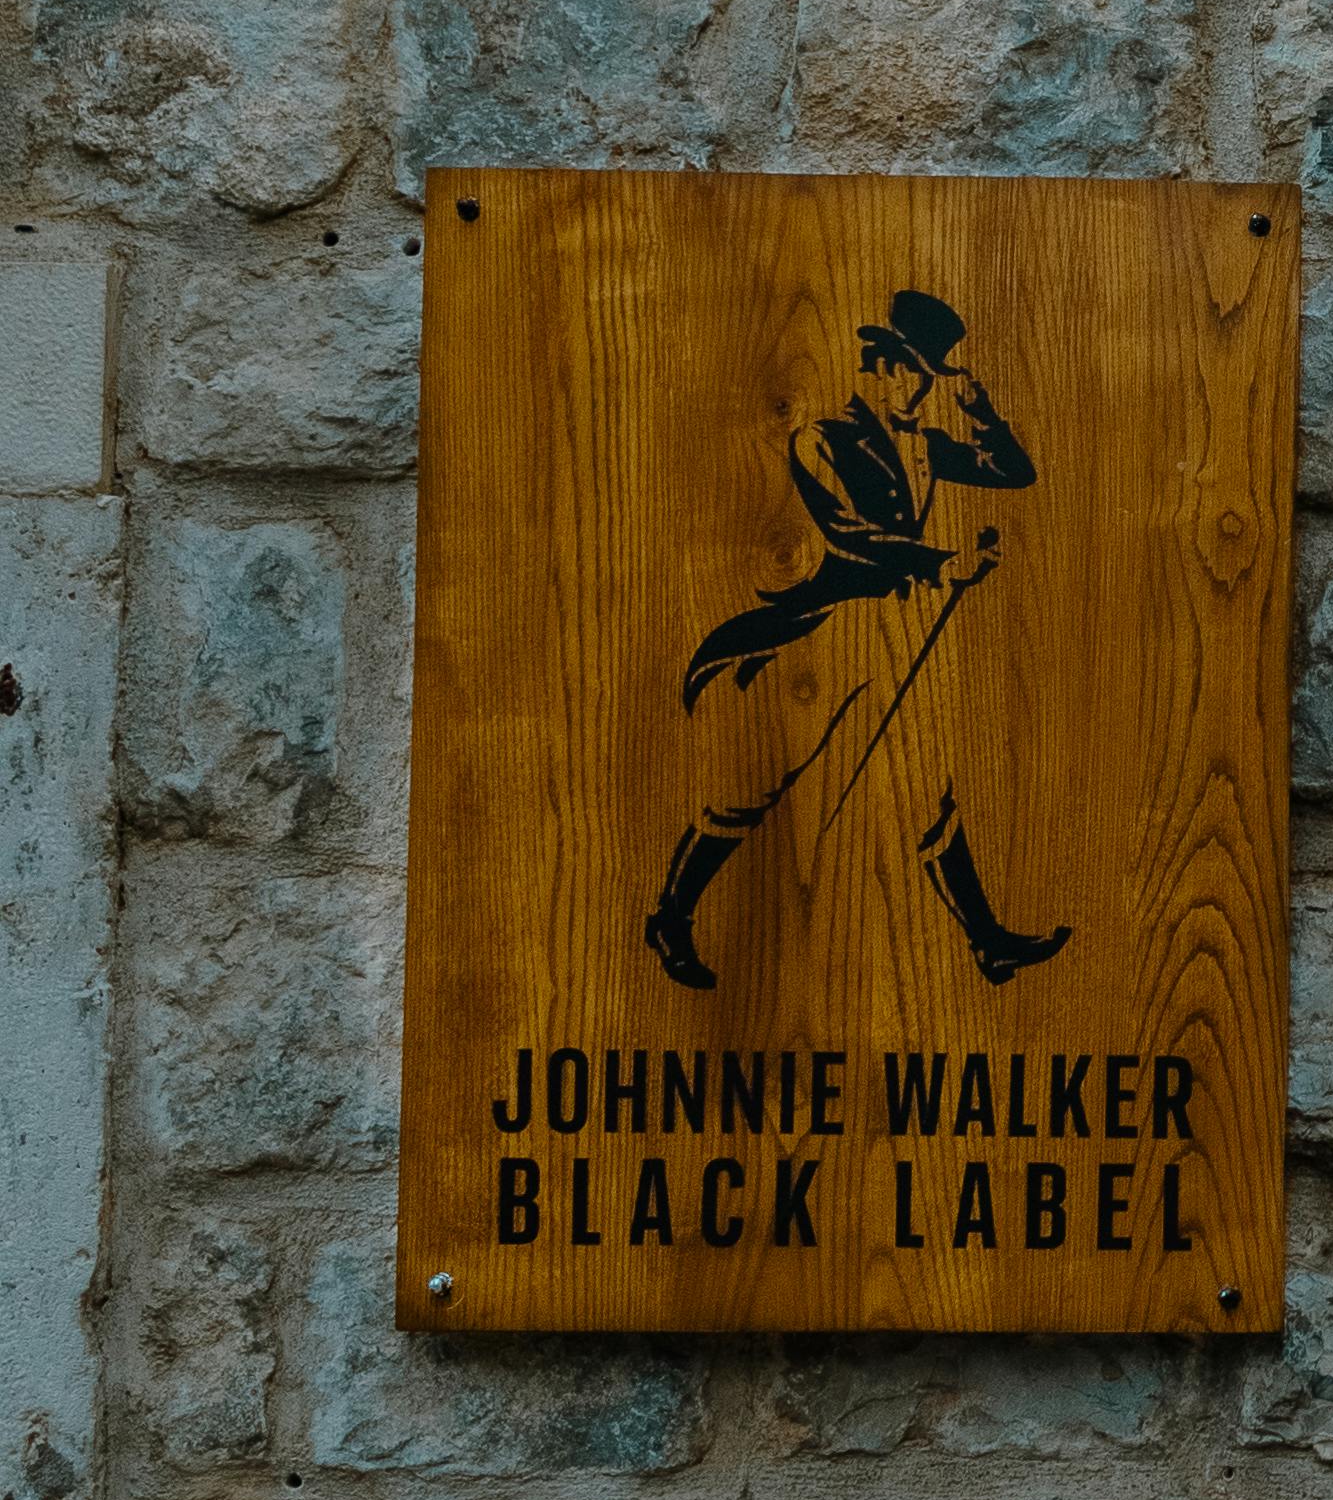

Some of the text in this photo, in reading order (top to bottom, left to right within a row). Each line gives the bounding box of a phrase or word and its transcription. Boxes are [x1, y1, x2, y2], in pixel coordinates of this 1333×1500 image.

[492, 1047, 1195, 1141] JOHNNIE WALKER
[496, 1156, 1194, 1253] BLACK LABEL
